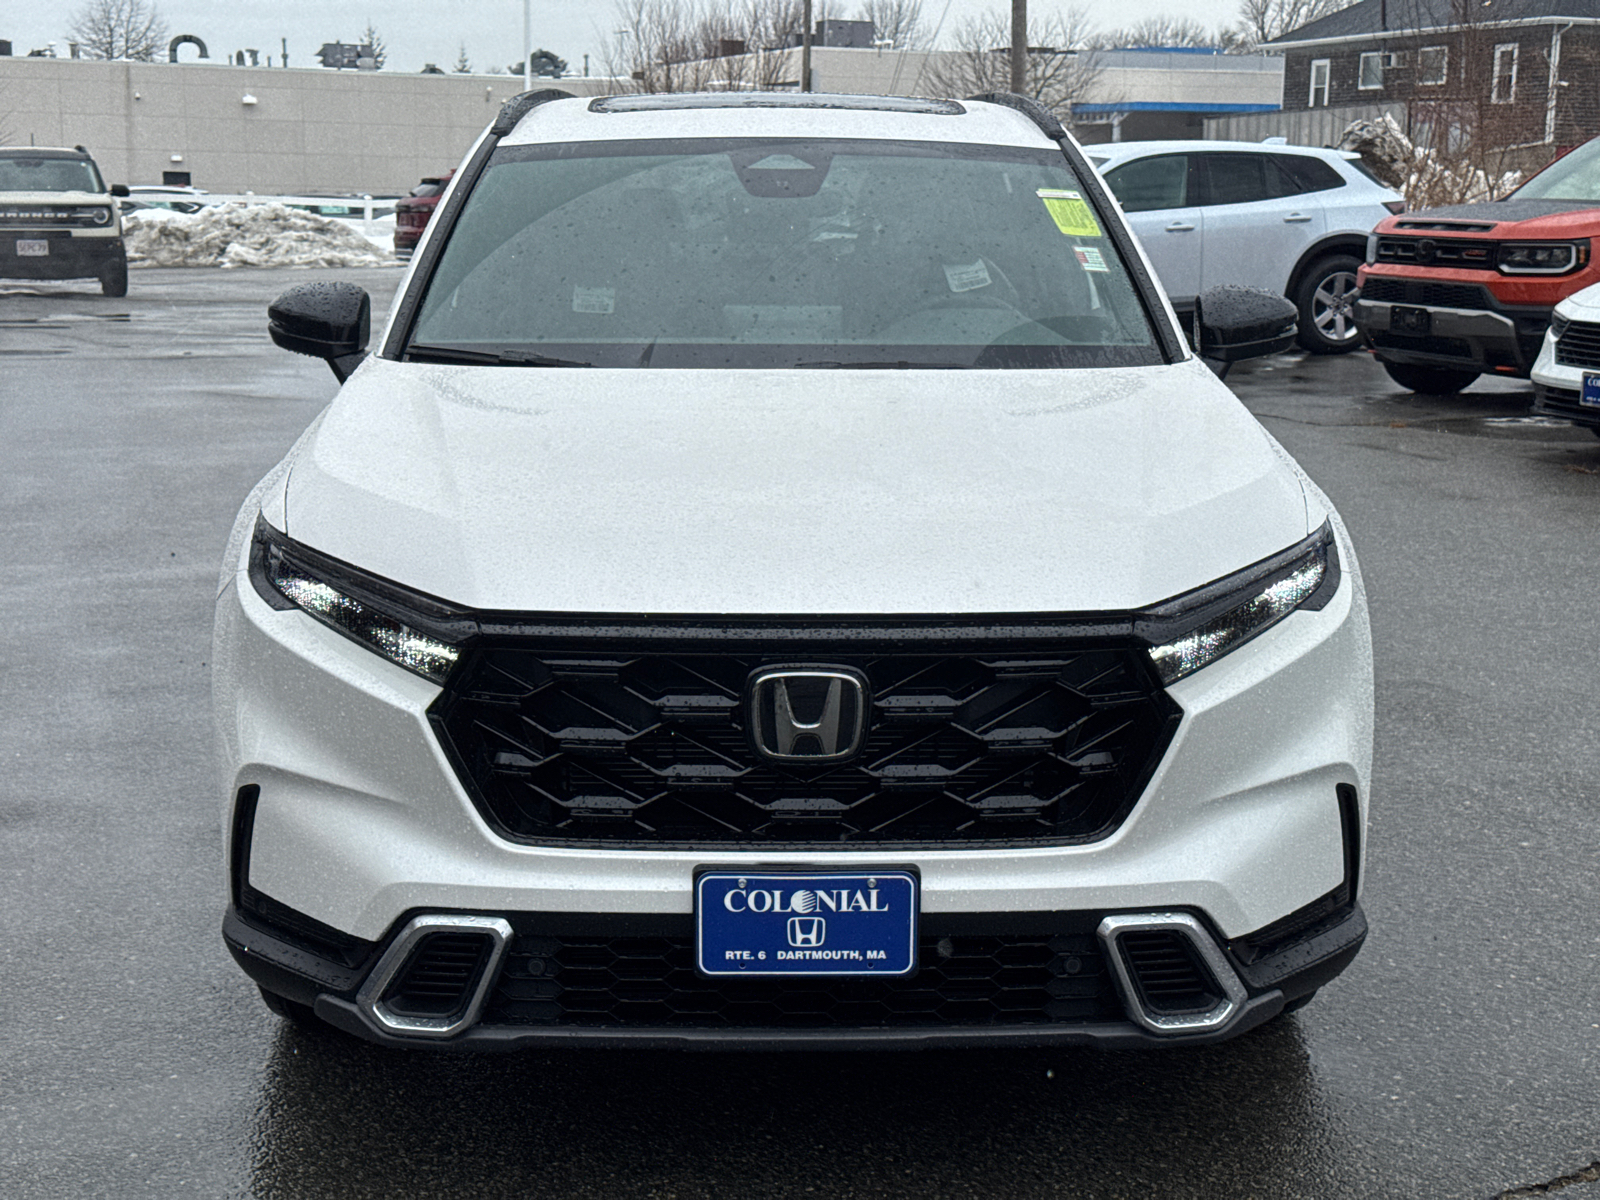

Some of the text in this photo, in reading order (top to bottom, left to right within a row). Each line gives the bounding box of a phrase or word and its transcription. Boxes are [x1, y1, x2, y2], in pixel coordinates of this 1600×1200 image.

[723, 889, 889, 914] COLONIAL
[725, 950, 887, 961] RTE. 6 DARTMOUTH, MA
